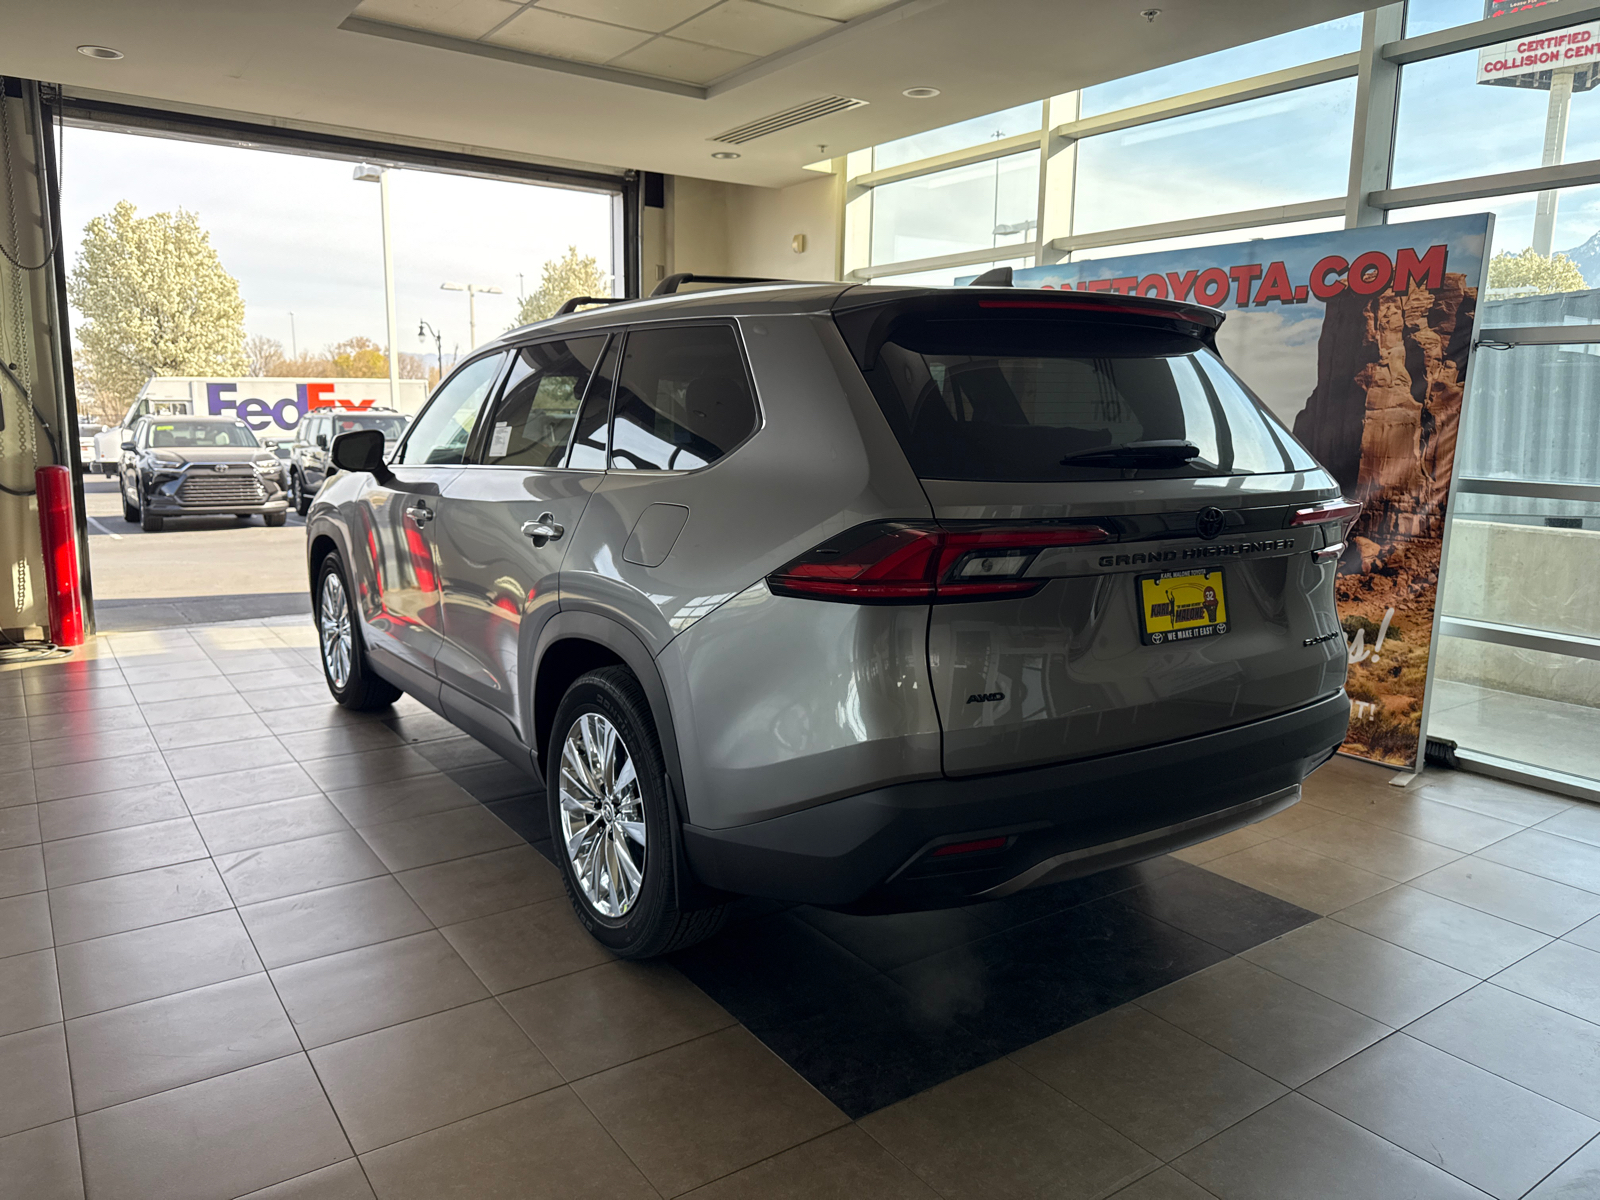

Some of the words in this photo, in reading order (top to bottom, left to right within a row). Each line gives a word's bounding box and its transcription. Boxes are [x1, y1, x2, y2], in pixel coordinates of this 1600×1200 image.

[1517, 30, 1591, 54] CERTIFIED
[1484, 50, 1560, 73] COLLISION
[1098, 549, 1177, 567] GRAND
[1182, 538, 1295, 560] HIGHLANDER
[1205, 591, 1214, 601] 32
[1150, 602, 1171, 618] KARL
[1175, 606, 1205, 623] MALONE
[1167, 632, 1177, 641] WE
[1177, 630, 1192, 639] MAKE
[1193, 629, 1199, 637] IT
[1200, 627, 1213, 636] EASY
[966, 692, 1005, 704] AWD
